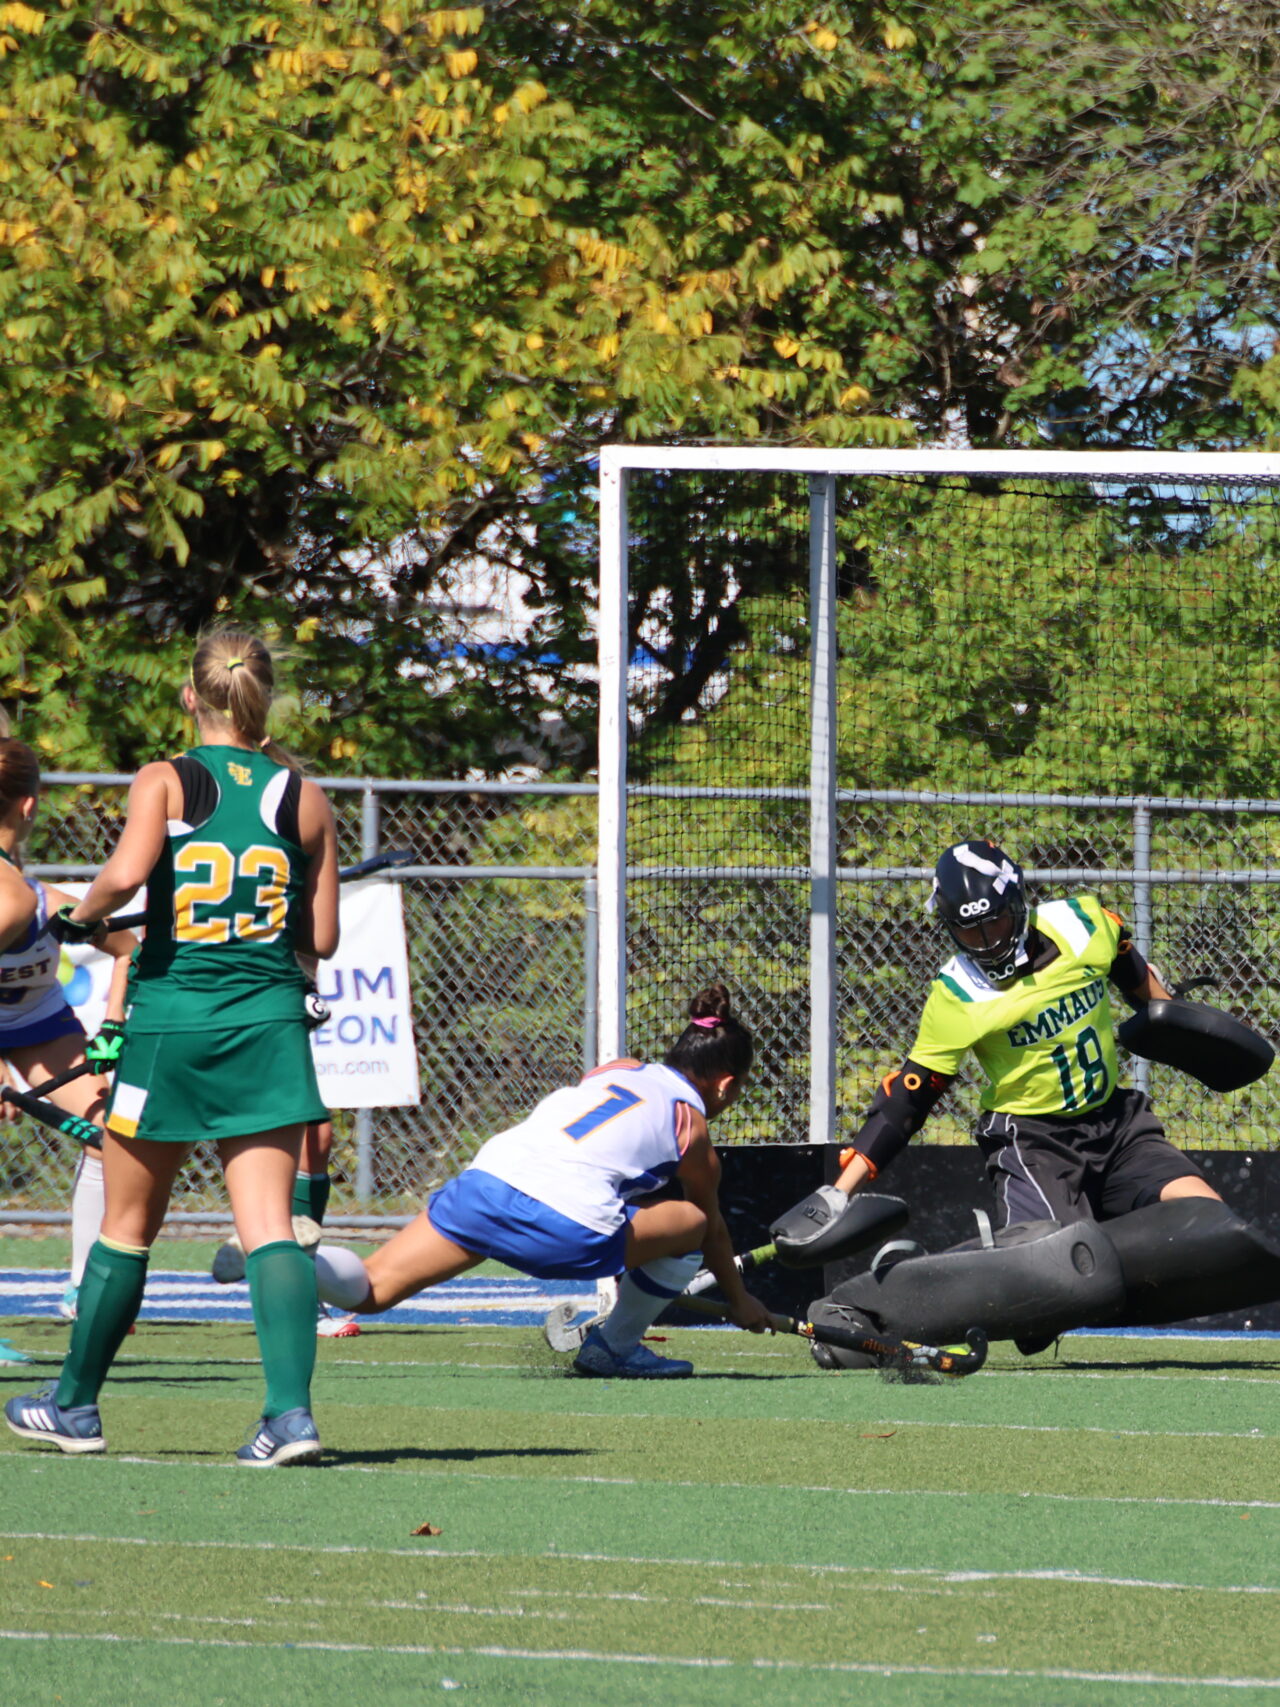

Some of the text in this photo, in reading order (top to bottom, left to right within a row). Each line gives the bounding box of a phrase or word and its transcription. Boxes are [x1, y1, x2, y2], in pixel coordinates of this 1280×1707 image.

[172, 842, 290, 944] 23
[960, 898, 990, 917] OBO
[1050, 1026, 1109, 1111] 18
[560, 1083, 646, 1144] 1
